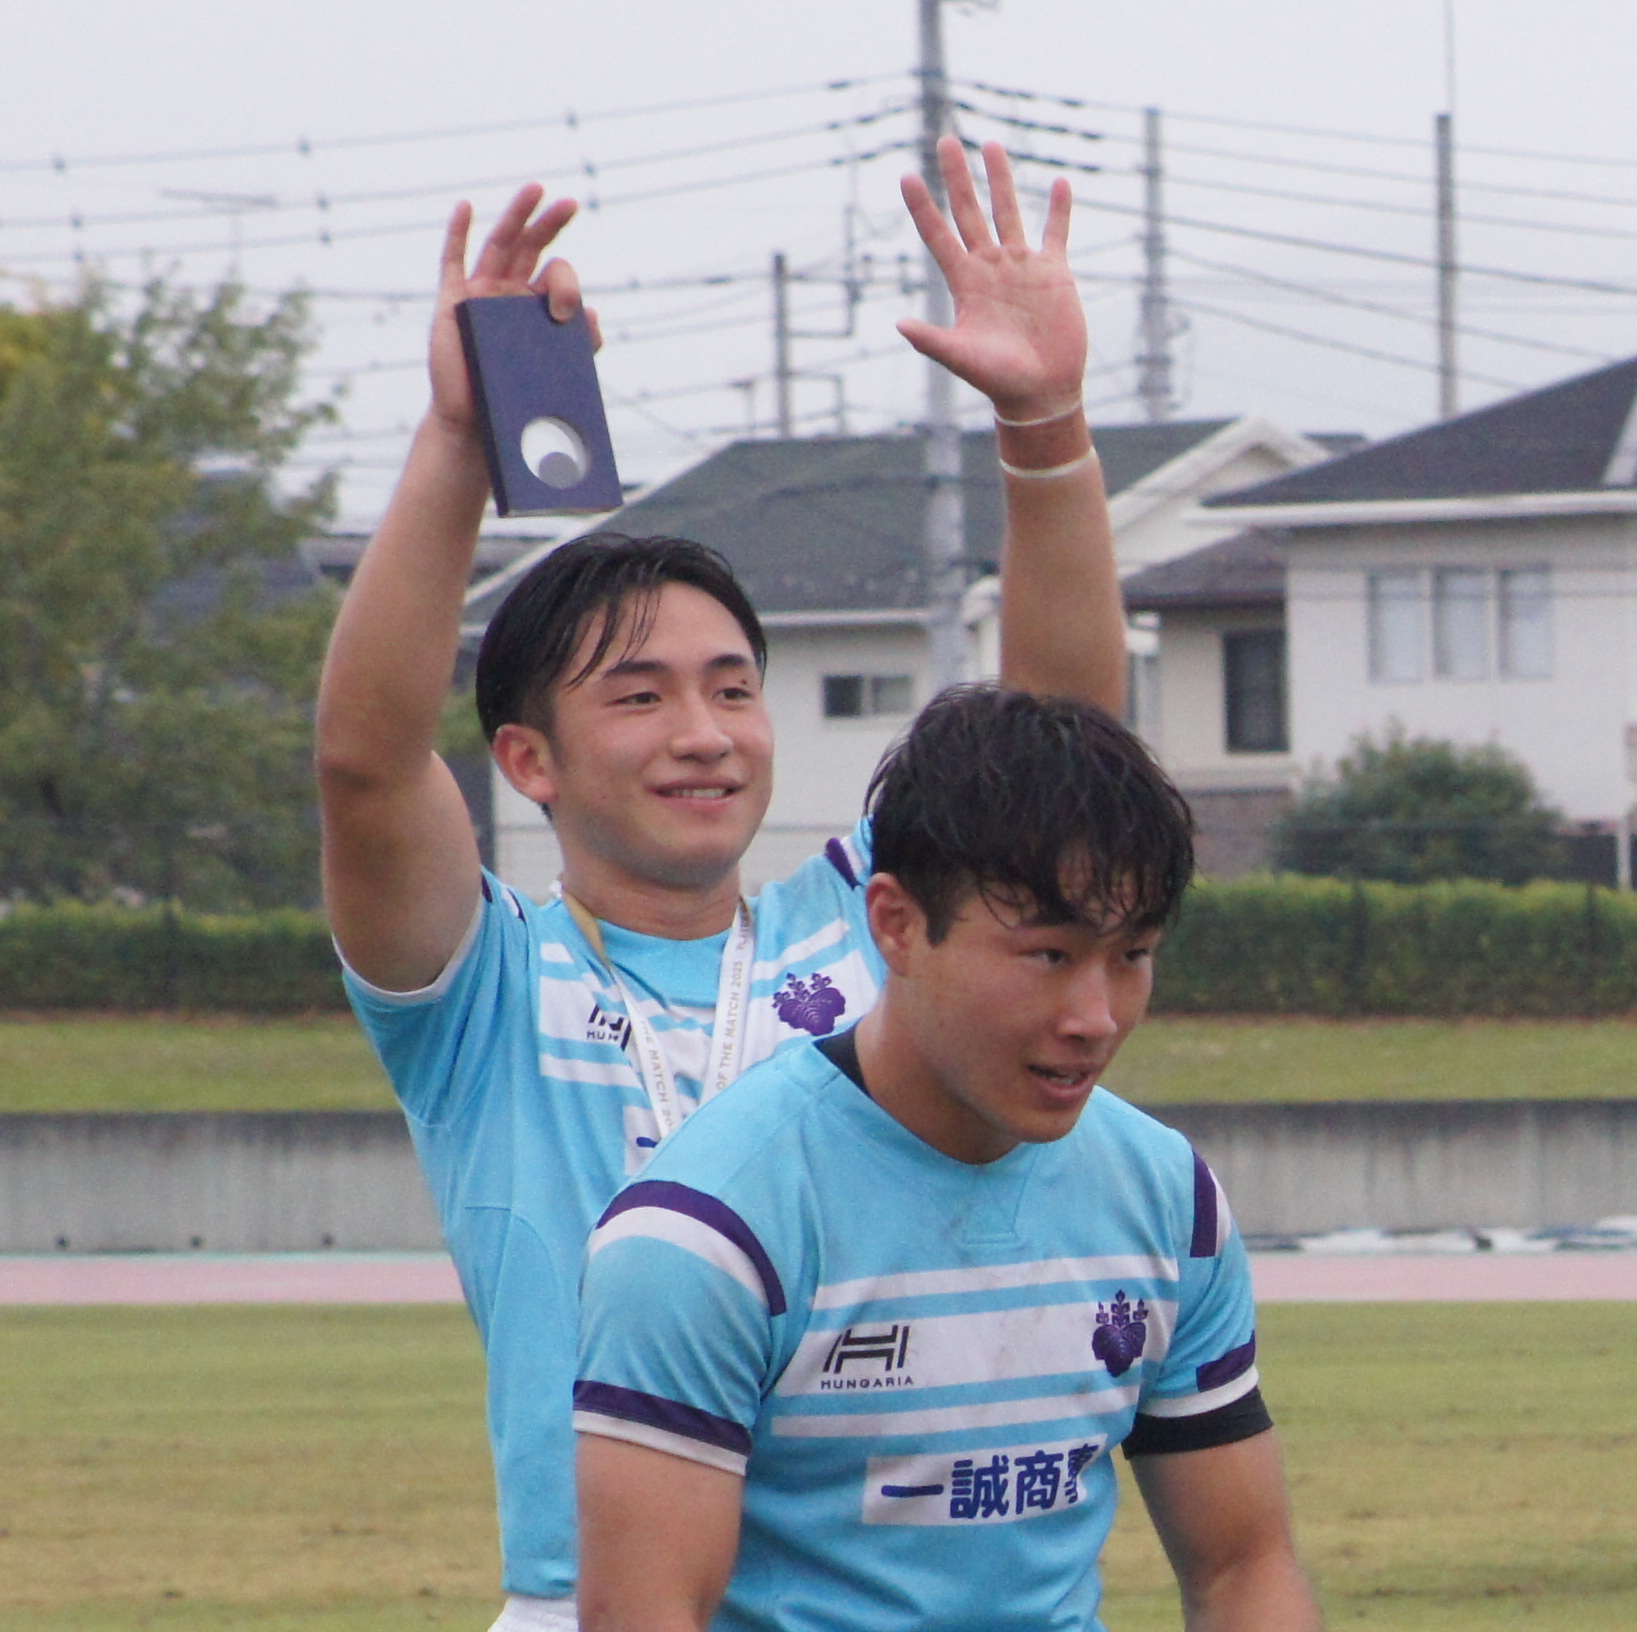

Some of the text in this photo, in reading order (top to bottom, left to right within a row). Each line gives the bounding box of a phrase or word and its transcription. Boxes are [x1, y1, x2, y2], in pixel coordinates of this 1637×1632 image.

[725, 994, 741, 1039] MATCH
[720, 1043, 733, 1068] THE
[650, 1049, 669, 1103] MATCH
[716, 1073, 728, 1090] OF
[820, 1375, 915, 1391] HUNGARIA
